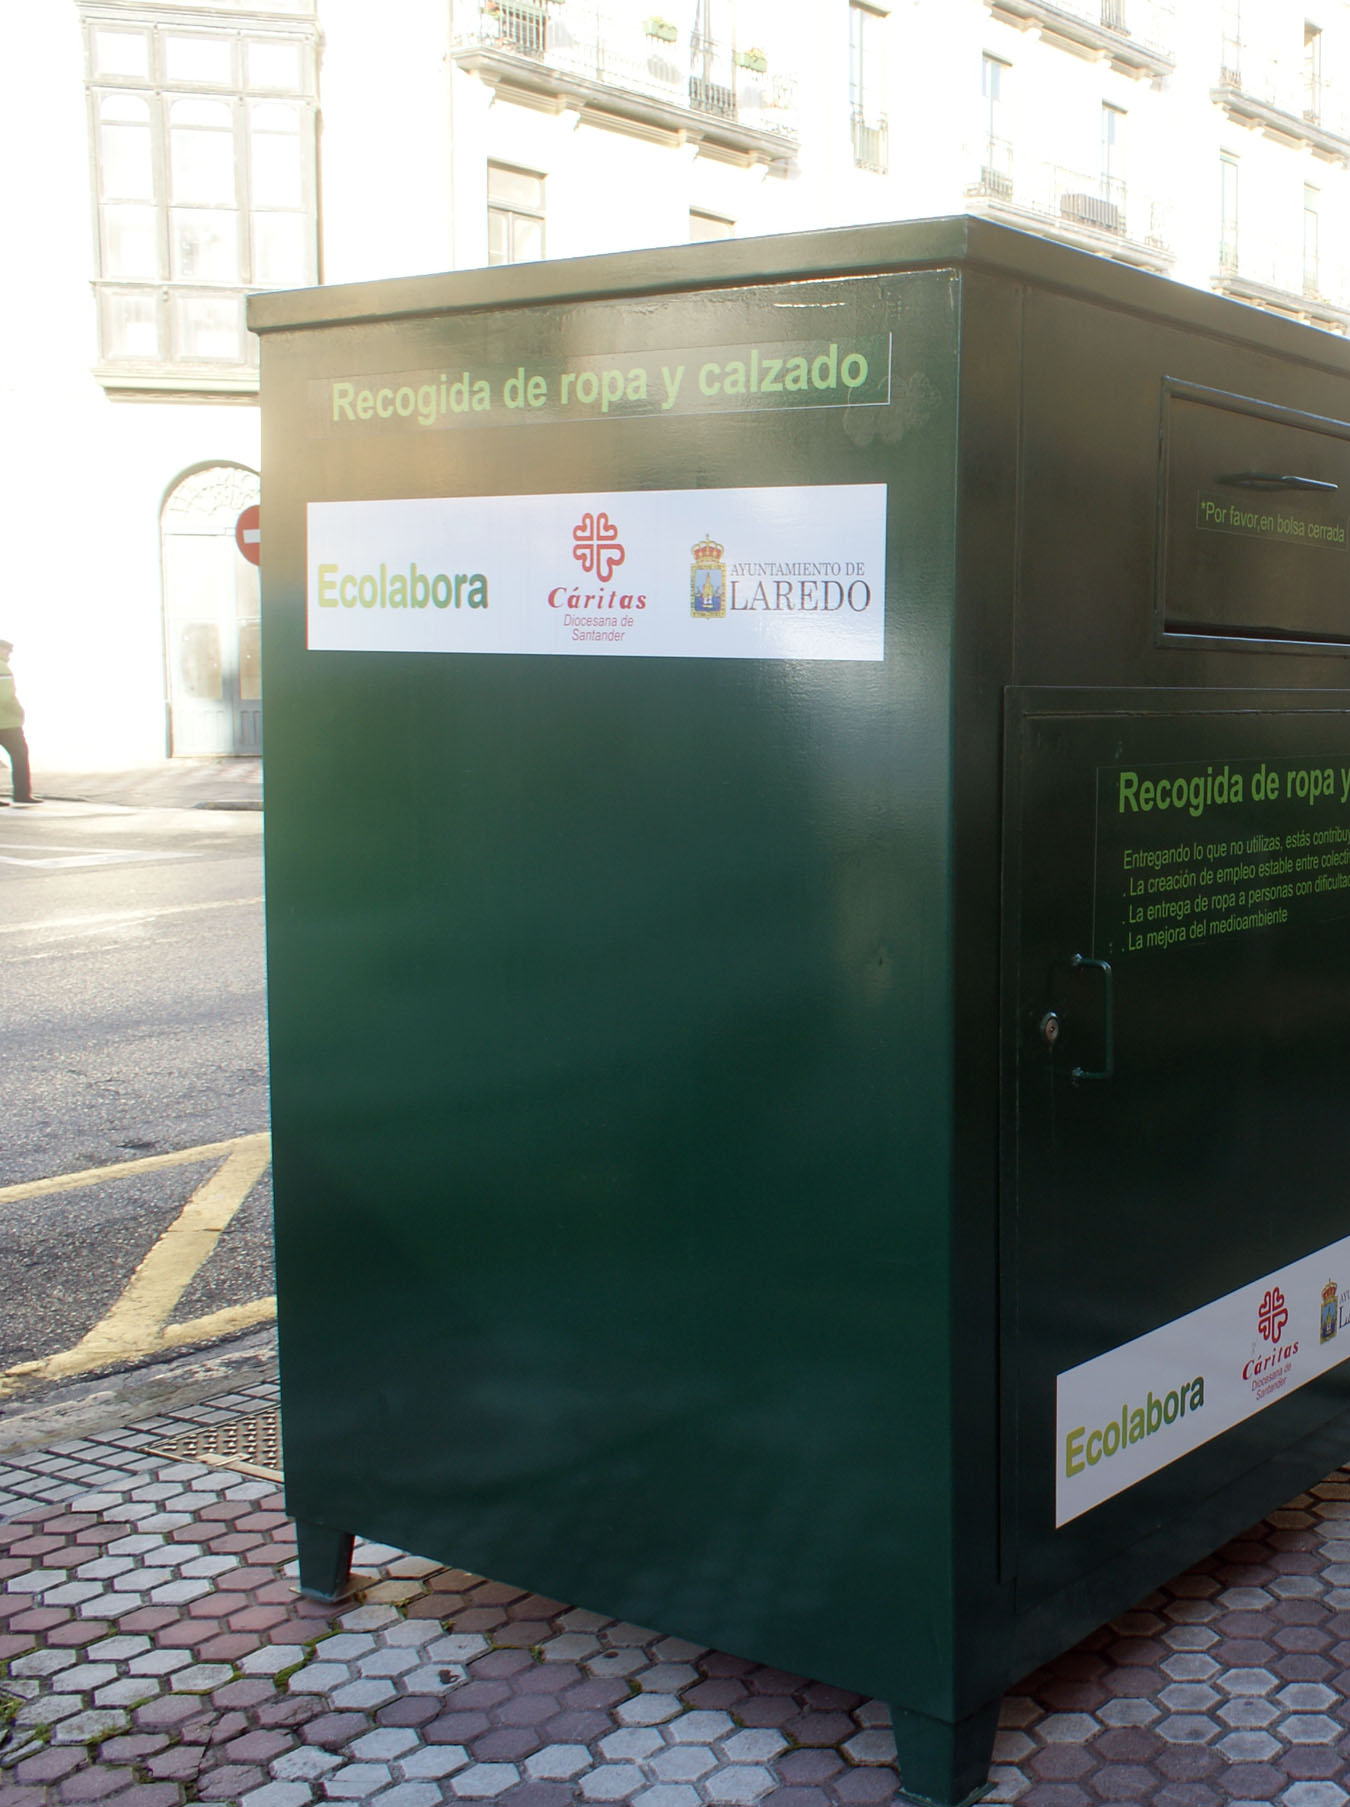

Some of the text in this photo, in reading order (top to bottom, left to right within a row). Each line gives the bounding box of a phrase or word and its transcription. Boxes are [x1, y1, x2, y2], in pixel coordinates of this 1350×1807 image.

[332, 344, 869, 425] Recogida de ropa y calzado
[1277, 513, 1305, 536] bolsa
[1307, 523, 1345, 543] cerrada
[318, 563, 488, 610] Ecolabora
[731, 562, 866, 577] AYUNTAMIENTO DE
[547, 586, 648, 610] Cáritas
[730, 579, 872, 613] LAREDO
[563, 613, 634, 629] Diocesana de
[571, 628, 625, 643] Santander
[1118, 765, 1243, 817] Recogida
[1251, 763, 1279, 801] de
[1287, 766, 1334, 805] ropa
[1124, 843, 1190, 870] Entregando
[1193, 842, 1203, 860] lo
[1206, 843, 1227, 862] que
[1230, 841, 1243, 855] no
[1285, 830, 1311, 848] estás
[1130, 877, 1145, 896] La
[1148, 869, 1196, 893] creación
[1200, 867, 1213, 886] de
[1216, 863, 1256, 885] empleo
[1258, 856, 1293, 877] estable
[1295, 853, 1319, 872] entre
[1129, 904, 1144, 923] La
[1147, 899, 1191, 920] entrega
[1194, 894, 1208, 913] de
[1211, 893, 1236, 912] ropa
[1238, 891, 1245, 905] a
[1248, 883, 1294, 908] personas
[1295, 881, 1312, 896] con
[1128, 907, 1288, 951] La mejora del medioambiente
[1242, 1341, 1299, 1380] Cáritas
[1065, 1375, 1205, 1478] Ecolabora
